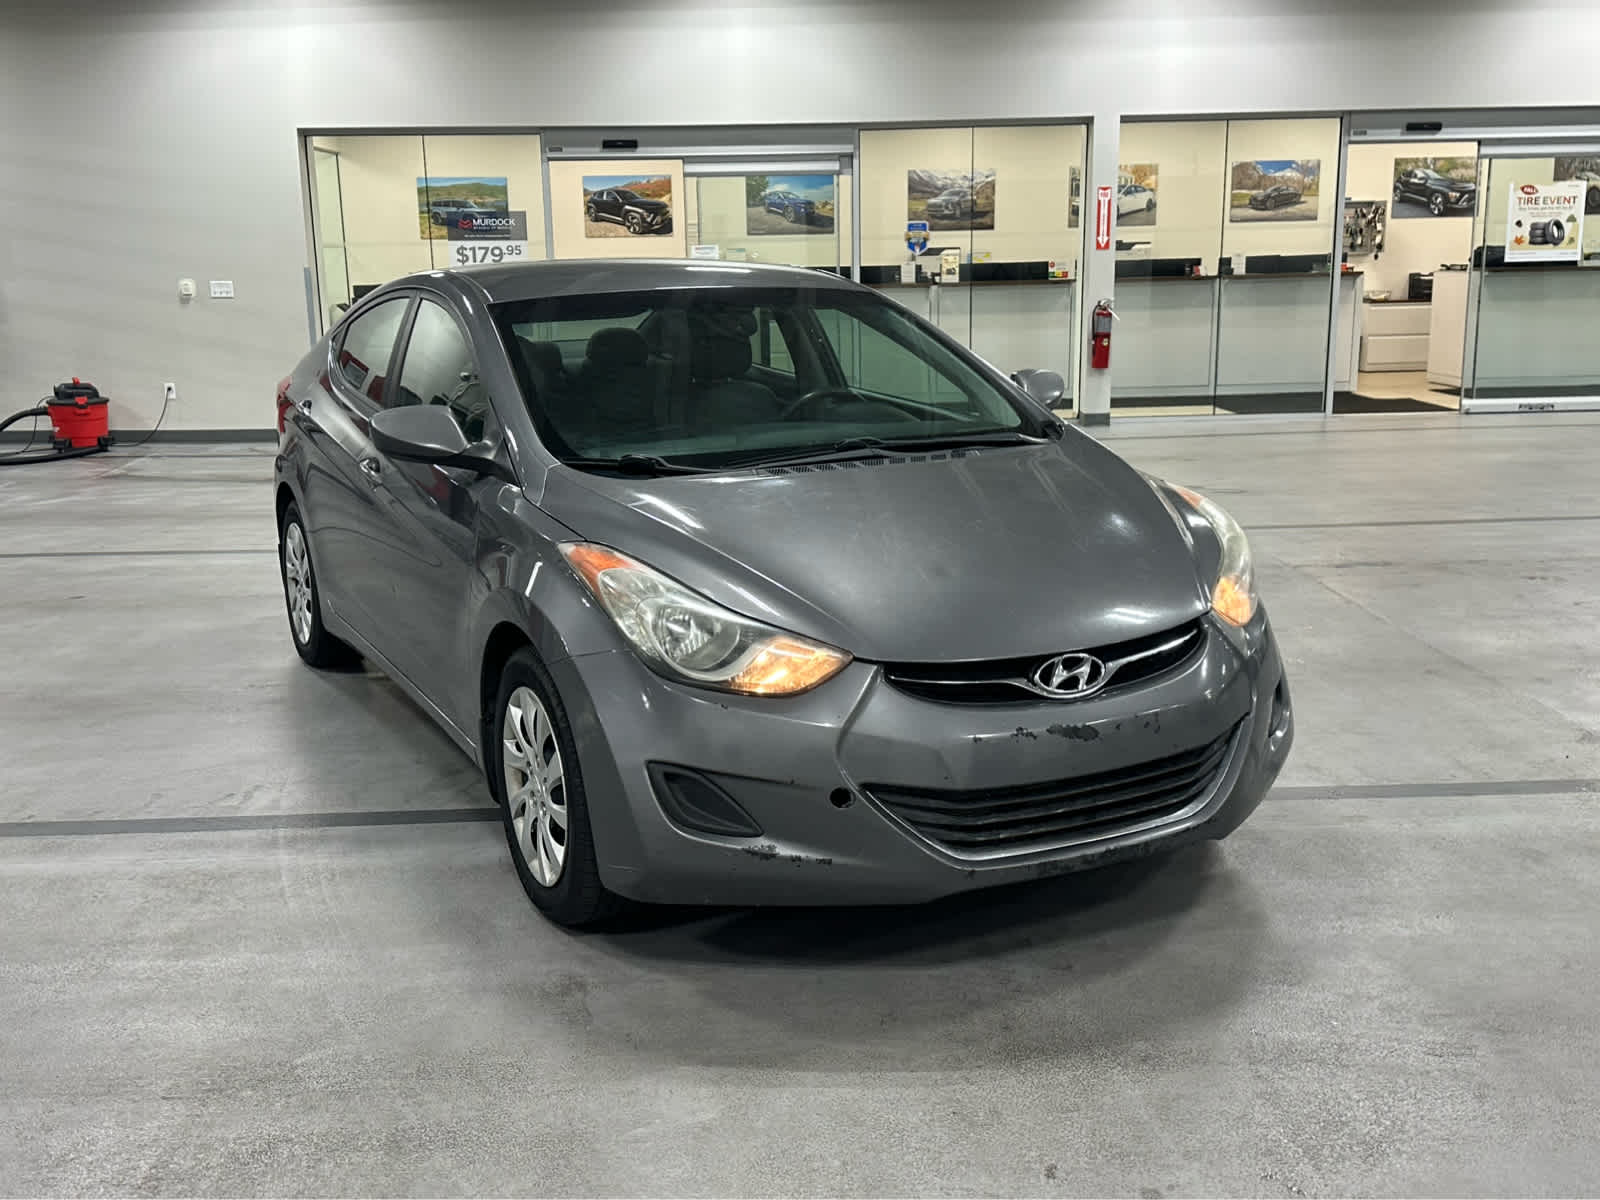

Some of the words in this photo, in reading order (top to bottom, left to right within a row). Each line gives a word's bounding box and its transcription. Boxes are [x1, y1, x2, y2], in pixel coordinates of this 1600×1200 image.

[1517, 196, 1540, 205] TIRE
[1542, 195, 1577, 205] EVENT
[473, 218, 516, 226] MURDOCK
[456, 245, 522, 265] $179.95
